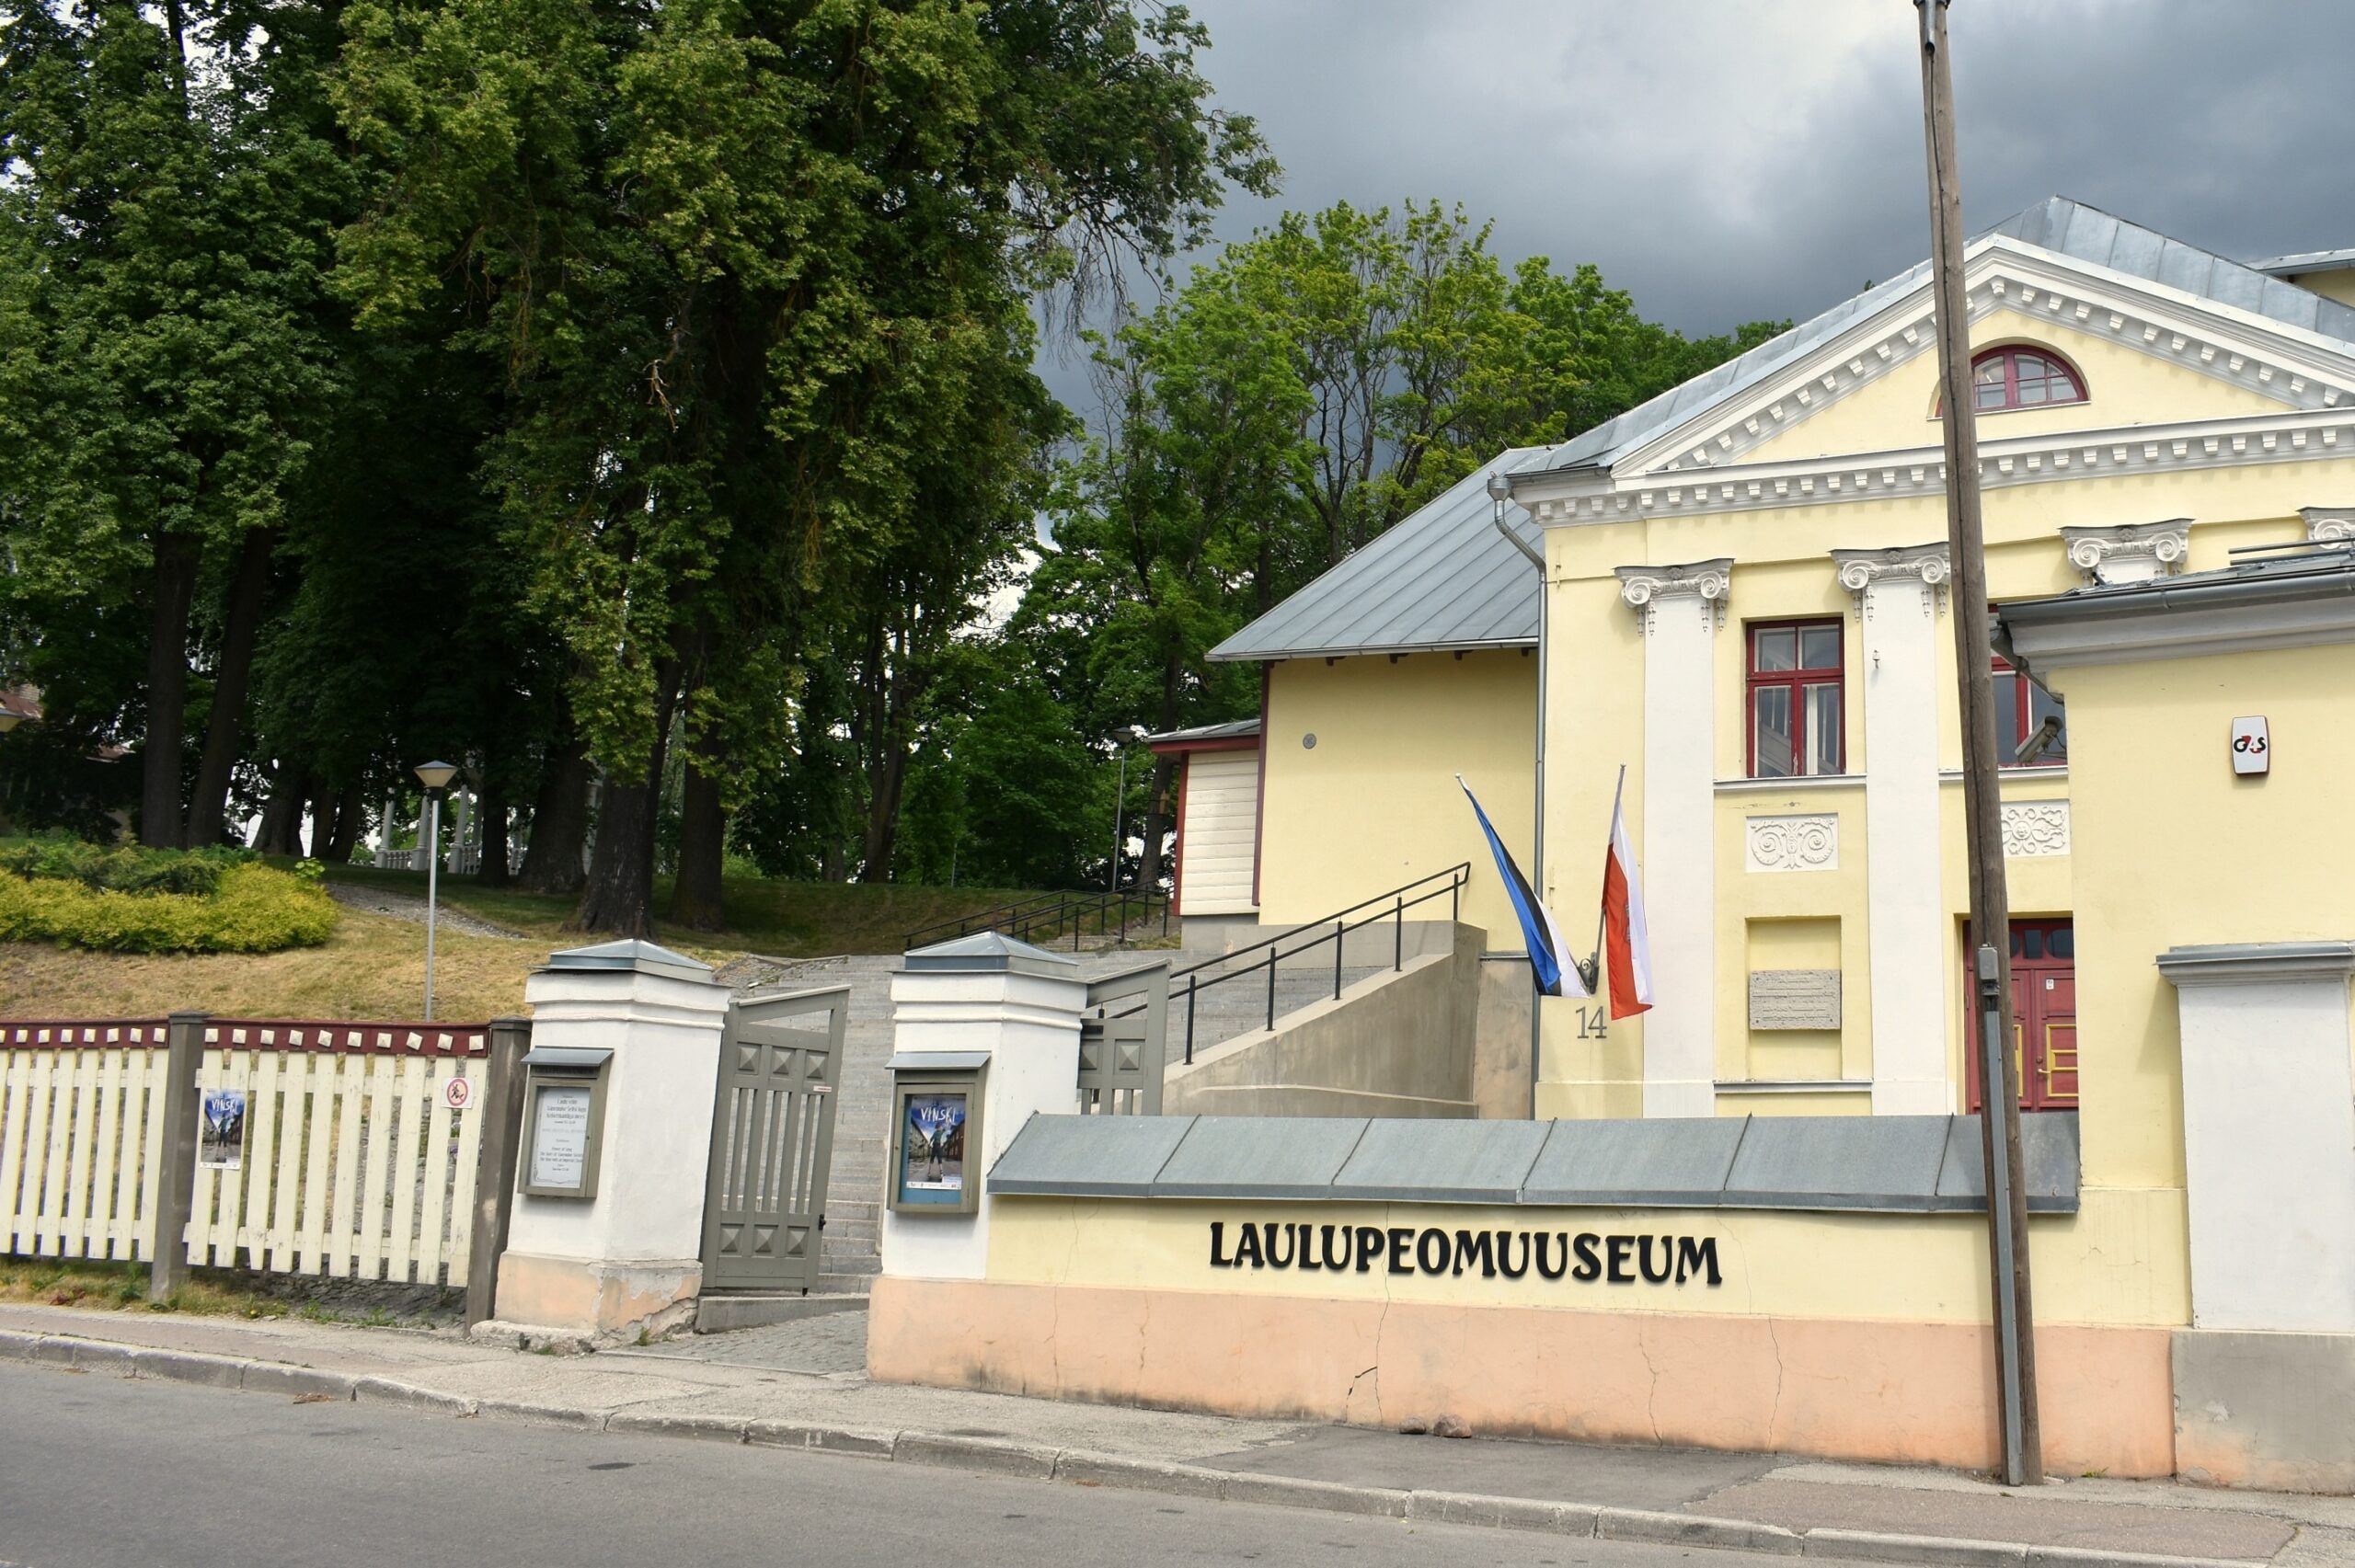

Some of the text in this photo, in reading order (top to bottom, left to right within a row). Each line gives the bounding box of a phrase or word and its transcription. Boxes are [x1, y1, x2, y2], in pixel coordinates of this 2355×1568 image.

[1576, 1006, 1607, 1039] 14
[921, 1106, 956, 1124] VINSKI
[1210, 1221, 1723, 1285] LAULUPEOMUUSEUM
